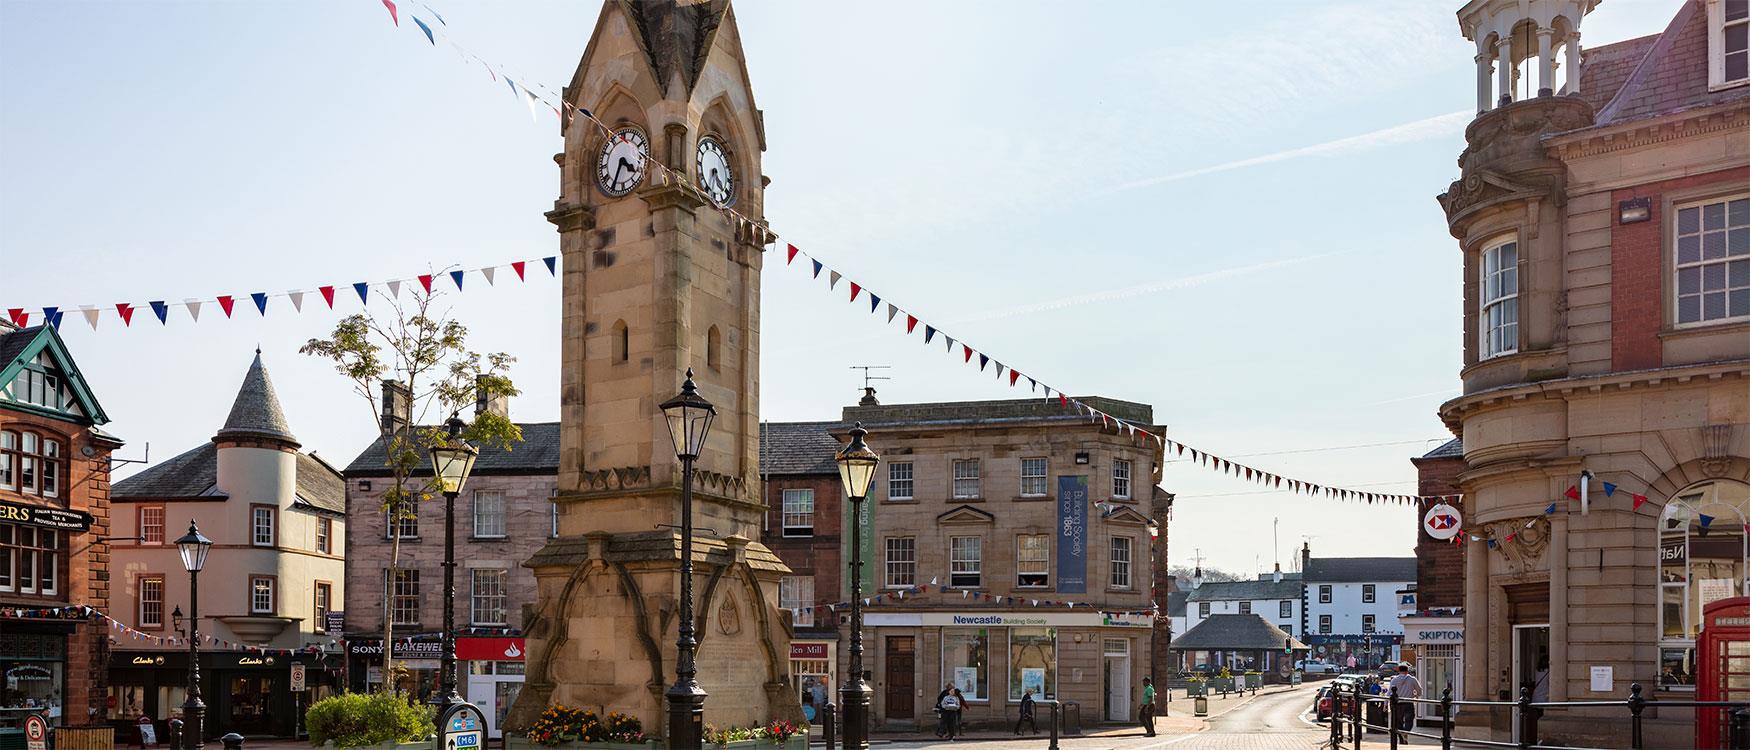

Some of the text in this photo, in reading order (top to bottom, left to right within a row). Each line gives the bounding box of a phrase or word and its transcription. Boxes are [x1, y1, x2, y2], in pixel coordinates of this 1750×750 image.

[34, 517, 57, 526] PROVISION
[1064, 516, 1072, 536] 1863
[1071, 491, 1083, 557] Building Society
[953, 615, 1002, 624] Newcastle
[1419, 631, 1464, 640] SKIPTON
[352, 646, 385, 654] SONY
[806, 645, 822, 654] Mill
[132, 656, 154, 664] Clarks
